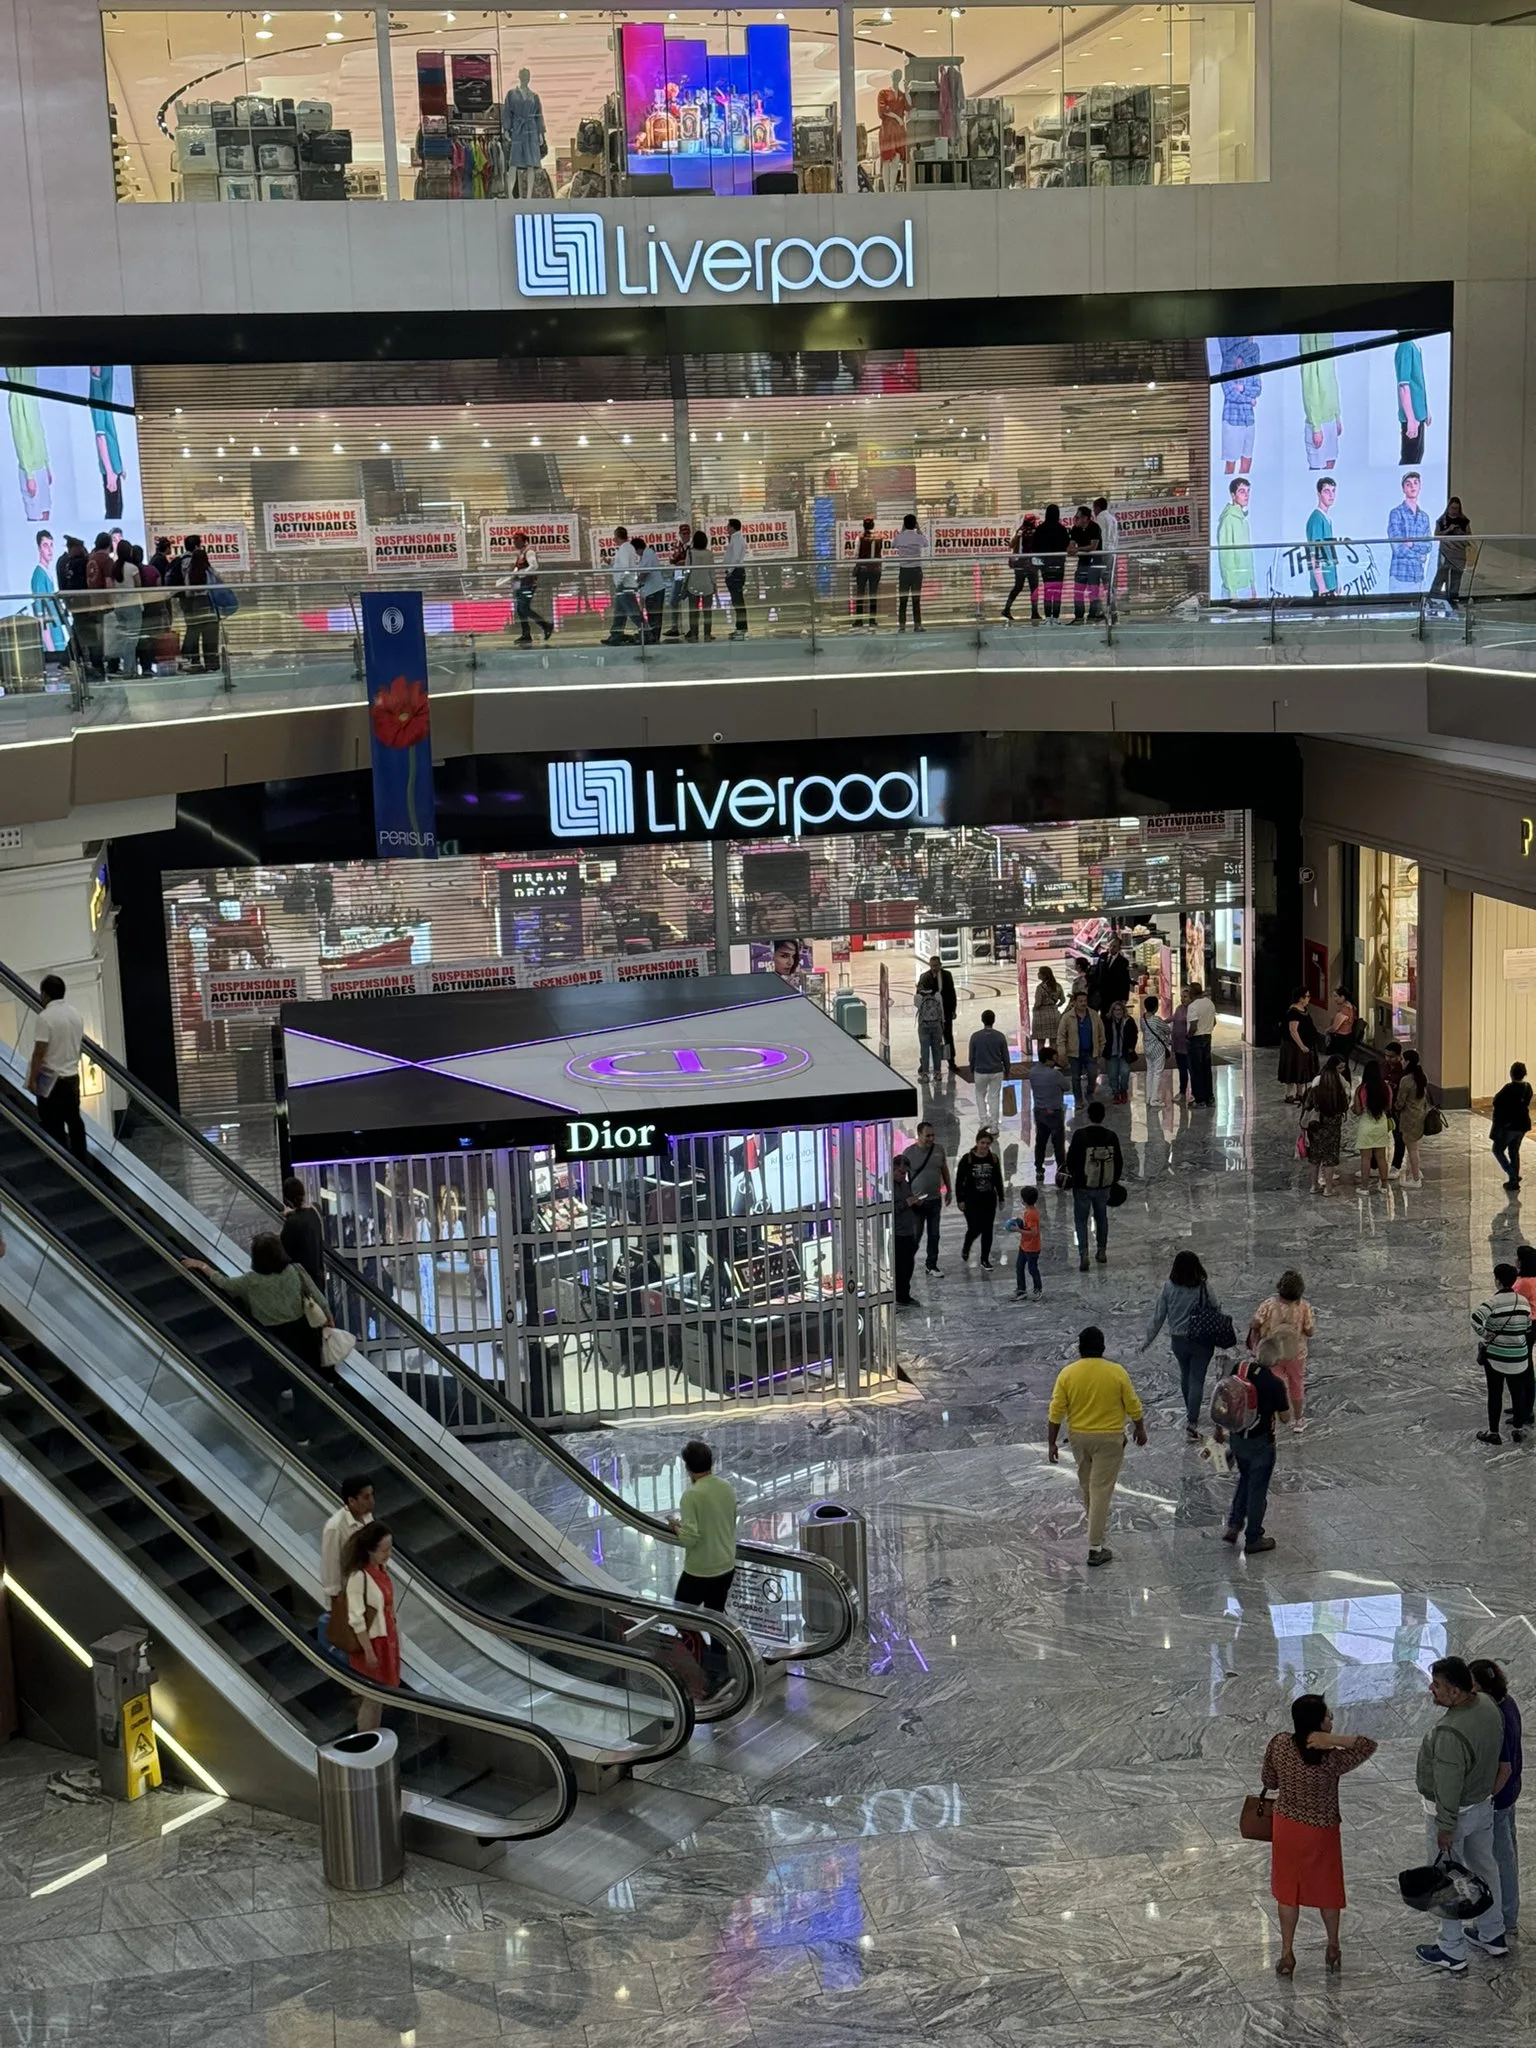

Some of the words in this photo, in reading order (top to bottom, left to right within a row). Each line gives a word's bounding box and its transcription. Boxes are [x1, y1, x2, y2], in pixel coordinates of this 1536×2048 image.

[616, 218, 914, 304] Liverpool
[273, 510, 340, 522] SUSPENSIÓN
[343, 511, 356, 520] DE
[1115, 507, 1174, 521] SUSPENSIÓN
[1177, 506, 1190, 515] DE
[274, 521, 357, 532] ACTIVIDADES
[775, 522, 788, 531] DE
[1117, 516, 1190, 530] ACTIVIDADES
[489, 524, 554, 536] SUSPENSIÓN
[556, 524, 570, 534] DE
[935, 527, 998, 538] SUSPENSIÓN
[999, 528, 1011, 536] DE
[225, 534, 238, 544] DE
[375, 533, 440, 546] SUSPENSIÓN
[443, 533, 456, 542] DE
[665, 532, 677, 542] DE
[935, 538, 1010, 548] ACTIVIDADES
[376, 544, 457, 556] ACTIVIDADES
[1282, 537, 1360, 578] THAT'S
[646, 756, 929, 836] Liverpool
[1147, 814, 1225, 828] ACTIVIDADES
[512, 871, 568, 886] URBAN
[514, 886, 567, 898] DECAY
[618, 960, 682, 976] SUSPENSIÓN
[686, 958, 699, 968] DE
[432, 966, 498, 982] SUSPENSIÓN
[502, 966, 516, 976] DE
[590, 970, 603, 980] DE
[210, 979, 280, 992] SUSPENSIÓN
[283, 979, 296, 988] DE
[330, 976, 398, 992] SUSPENSIÓN
[402, 975, 415, 984] DE
[432, 976, 516, 992] ACTIVIDADES
[212, 989, 298, 1002] ACTIVIDADES
[332, 985, 416, 1000] ACTIVIDADES
[566, 1120, 656, 1152] Dior
